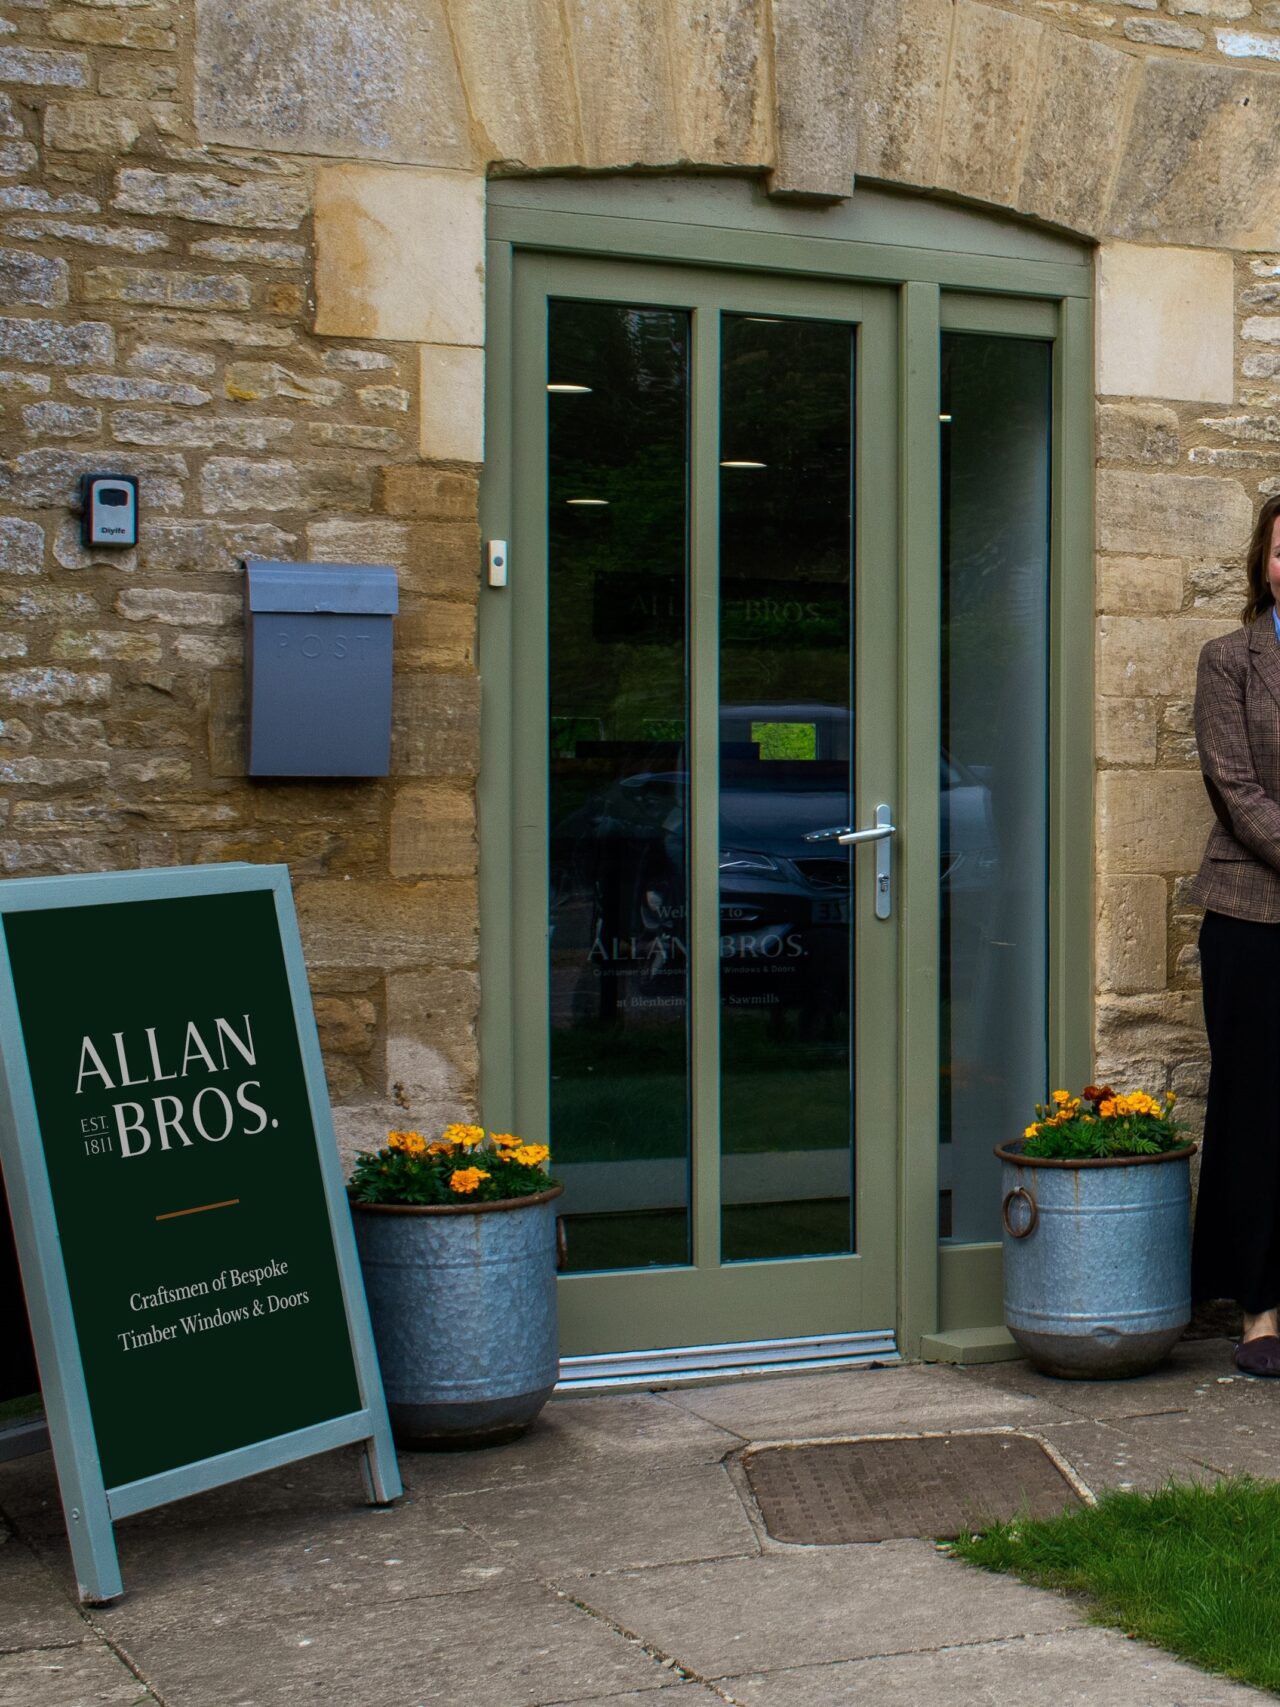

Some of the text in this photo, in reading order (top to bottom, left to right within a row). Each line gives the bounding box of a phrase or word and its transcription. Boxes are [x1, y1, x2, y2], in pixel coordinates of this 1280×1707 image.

[278, 632, 371, 659] POST
[728, 906, 743, 918] to
[720, 934, 809, 959] BROS.
[729, 993, 780, 1005] Sawmills
[75, 1014, 257, 1095] ALLAN
[81, 1115, 109, 1134] EST.
[112, 1080, 279, 1159] BROS.
[84, 1136, 113, 1156] 1811
[129, 1258, 289, 1312] Craftsmen of Bespoke
[117, 1290, 310, 1352] Timber Windows & Doors
